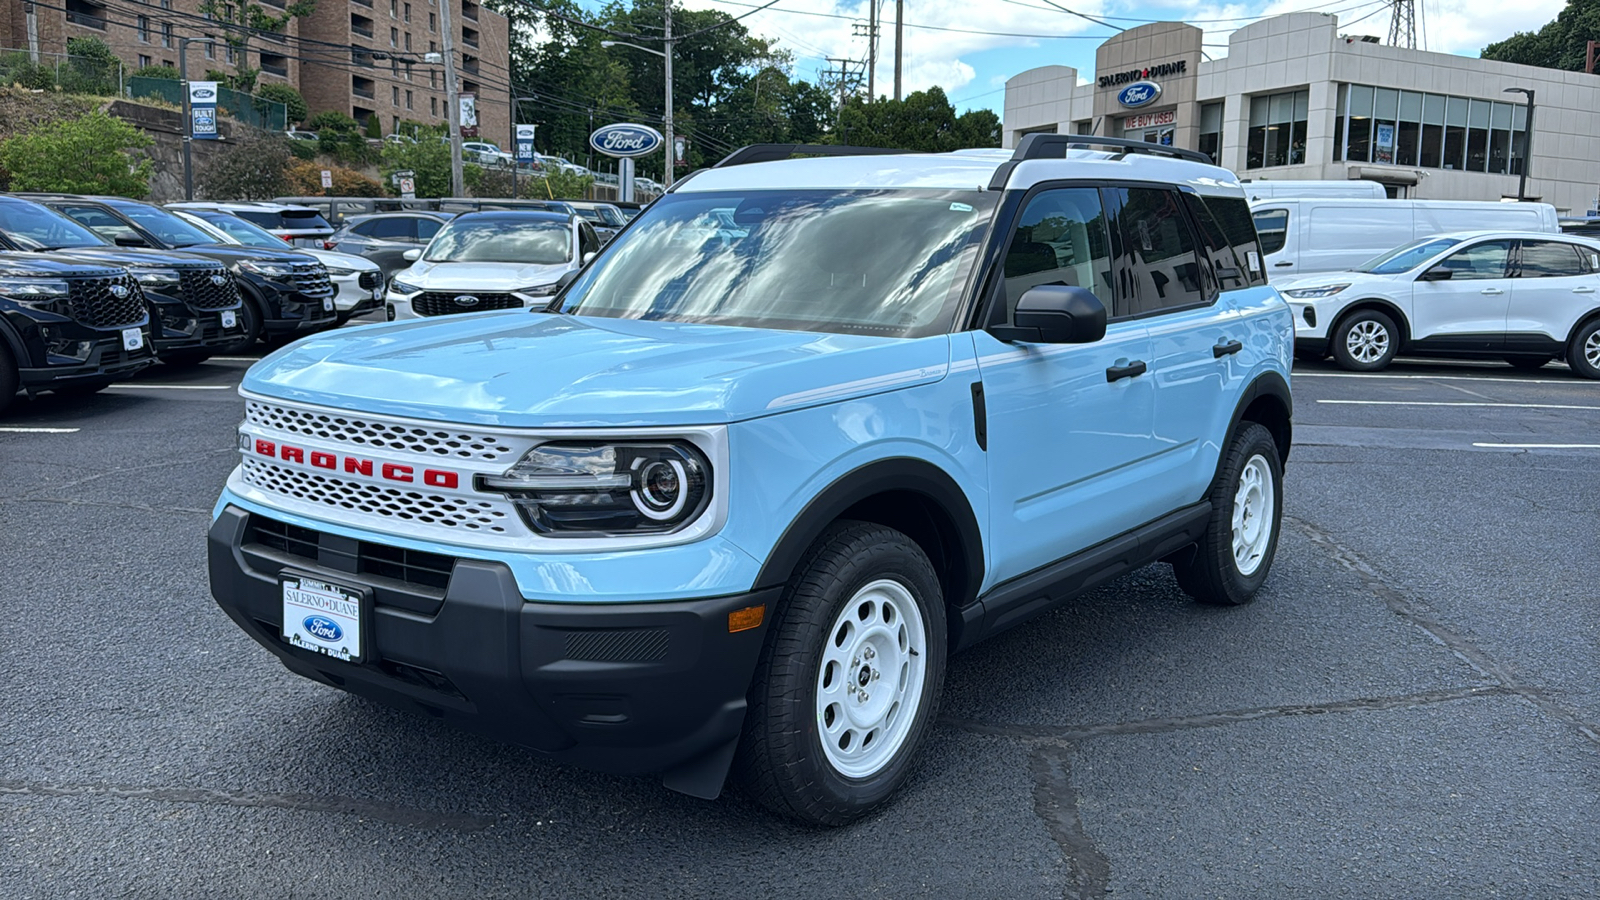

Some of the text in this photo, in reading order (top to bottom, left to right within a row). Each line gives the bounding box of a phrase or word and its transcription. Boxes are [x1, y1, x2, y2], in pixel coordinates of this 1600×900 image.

[1098, 60, 1187, 88] SALERNO DUANE
[1125, 86, 1149, 103] Ford
[194, 110, 213, 118] BUILT
[1125, 111, 1174, 128] WE BUY USED
[603, 130, 646, 150] Ford
[519, 151, 533, 159] CARS
[255, 438, 459, 490] BRONCO
[286, 590, 358, 618] SALERNO DUANE
[310, 618, 336, 639] Ford
[289, 637, 351, 661] SALERNO DUANE
